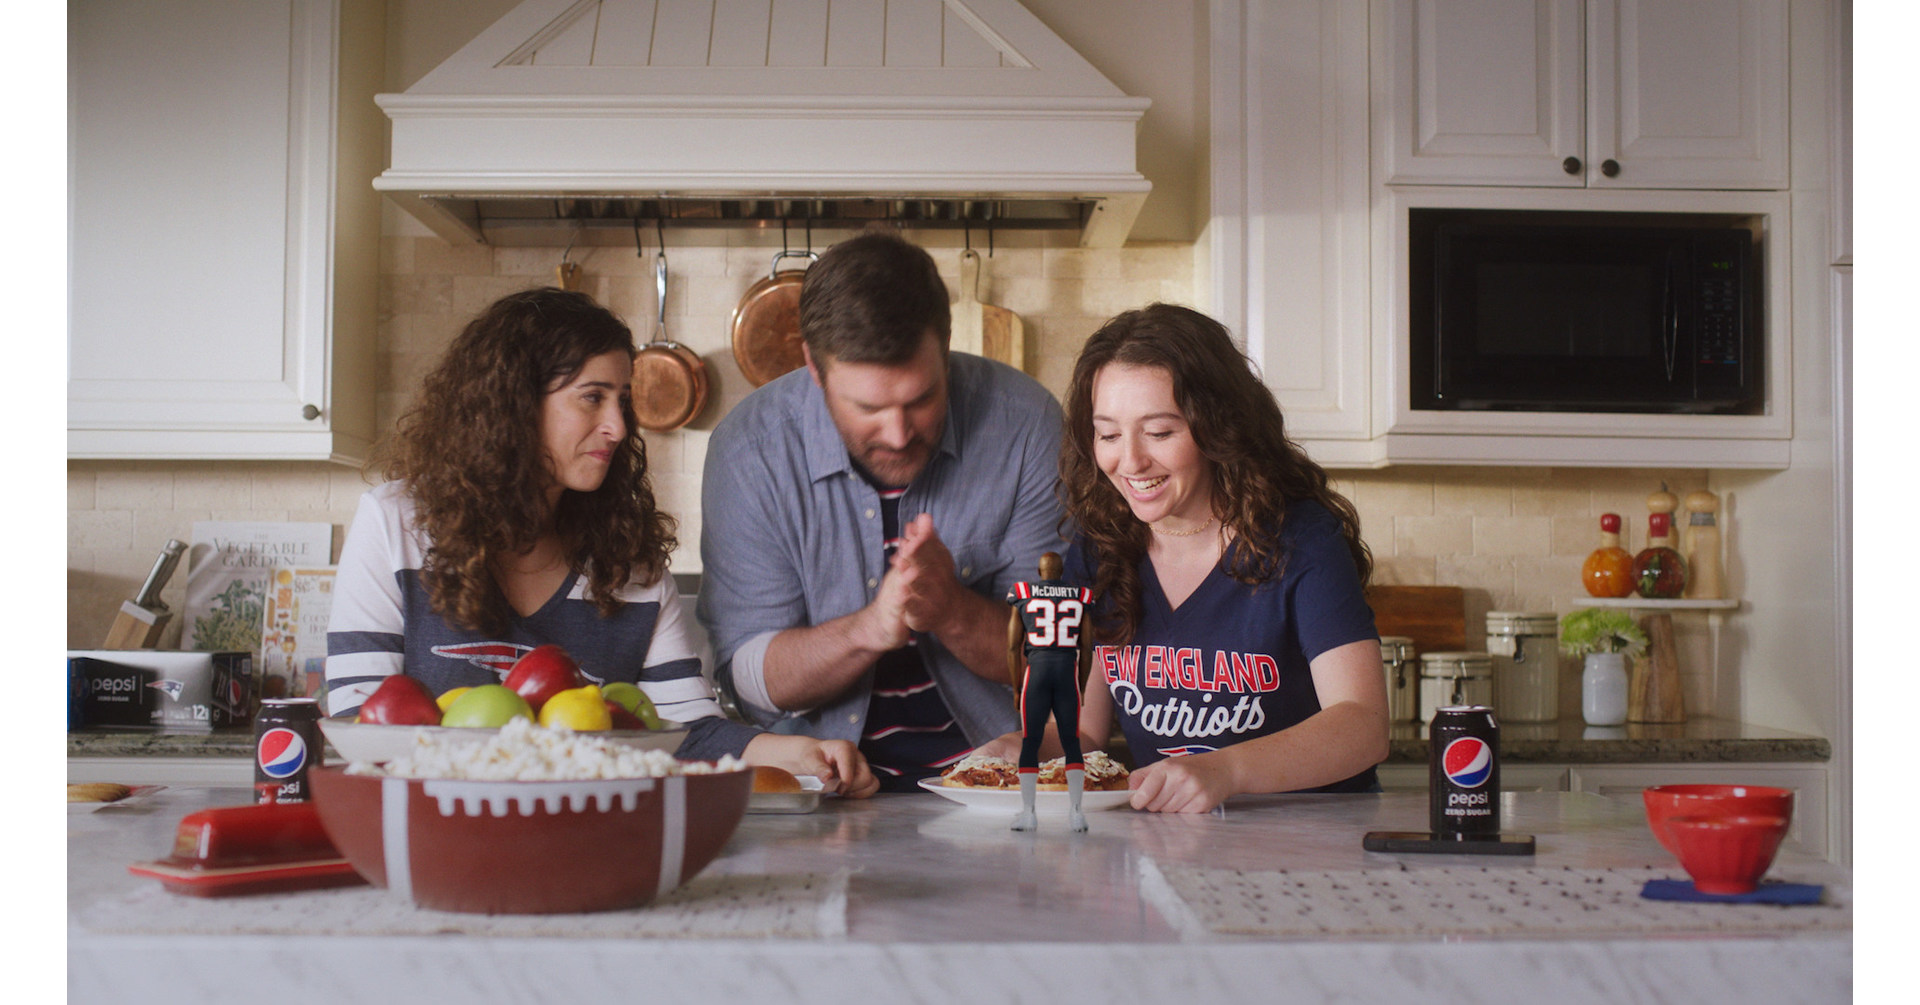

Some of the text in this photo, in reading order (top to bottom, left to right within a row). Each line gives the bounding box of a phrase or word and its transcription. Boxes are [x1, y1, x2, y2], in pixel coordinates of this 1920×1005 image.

[213, 538, 309, 554] VEGETABLE
[222, 555, 297, 568] GARDEN
[1031, 585, 1079, 598] McCOURTY
[1026, 598, 1084, 647] 32
[1145, 645, 1280, 694] ENGLAND
[91, 675, 136, 695] pepsi
[1110, 680, 1265, 738] Patriots
[1448, 791, 1488, 807] pepsi
[1444, 808, 1491, 816] ZERO SUGAR
